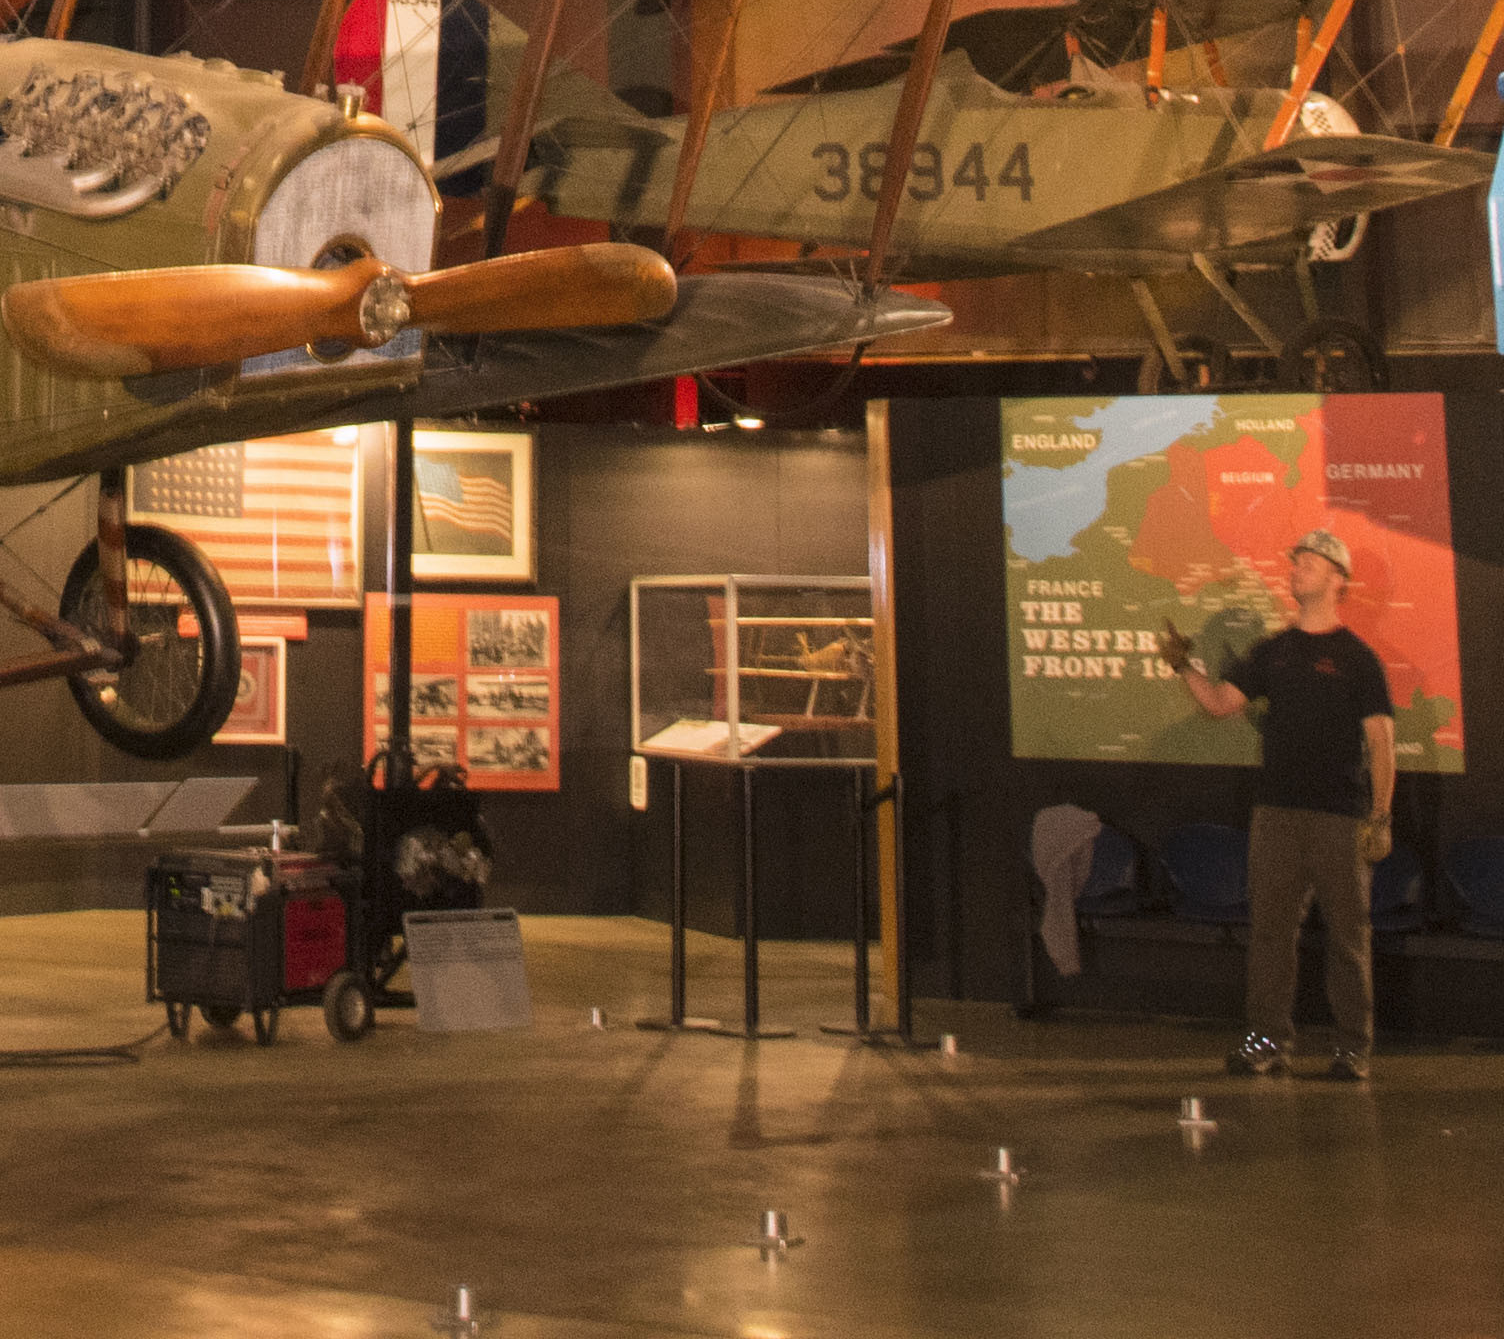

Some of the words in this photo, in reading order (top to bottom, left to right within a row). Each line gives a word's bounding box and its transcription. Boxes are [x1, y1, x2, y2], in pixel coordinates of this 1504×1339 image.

[811, 141, 1035, 203] 38944
[1235, 418, 1296, 432] HOLLAND
[1012, 433, 1097, 451] ENGLAND
[1220, 471, 1275, 484] BELGIUM
[1326, 463, 1425, 480] GERMANY
[1027, 580, 1104, 598] FRANCE
[1020, 601, 1084, 624] THE
[1021, 629, 1169, 653] WESTER
[1023, 655, 1127, 680] FRONT
